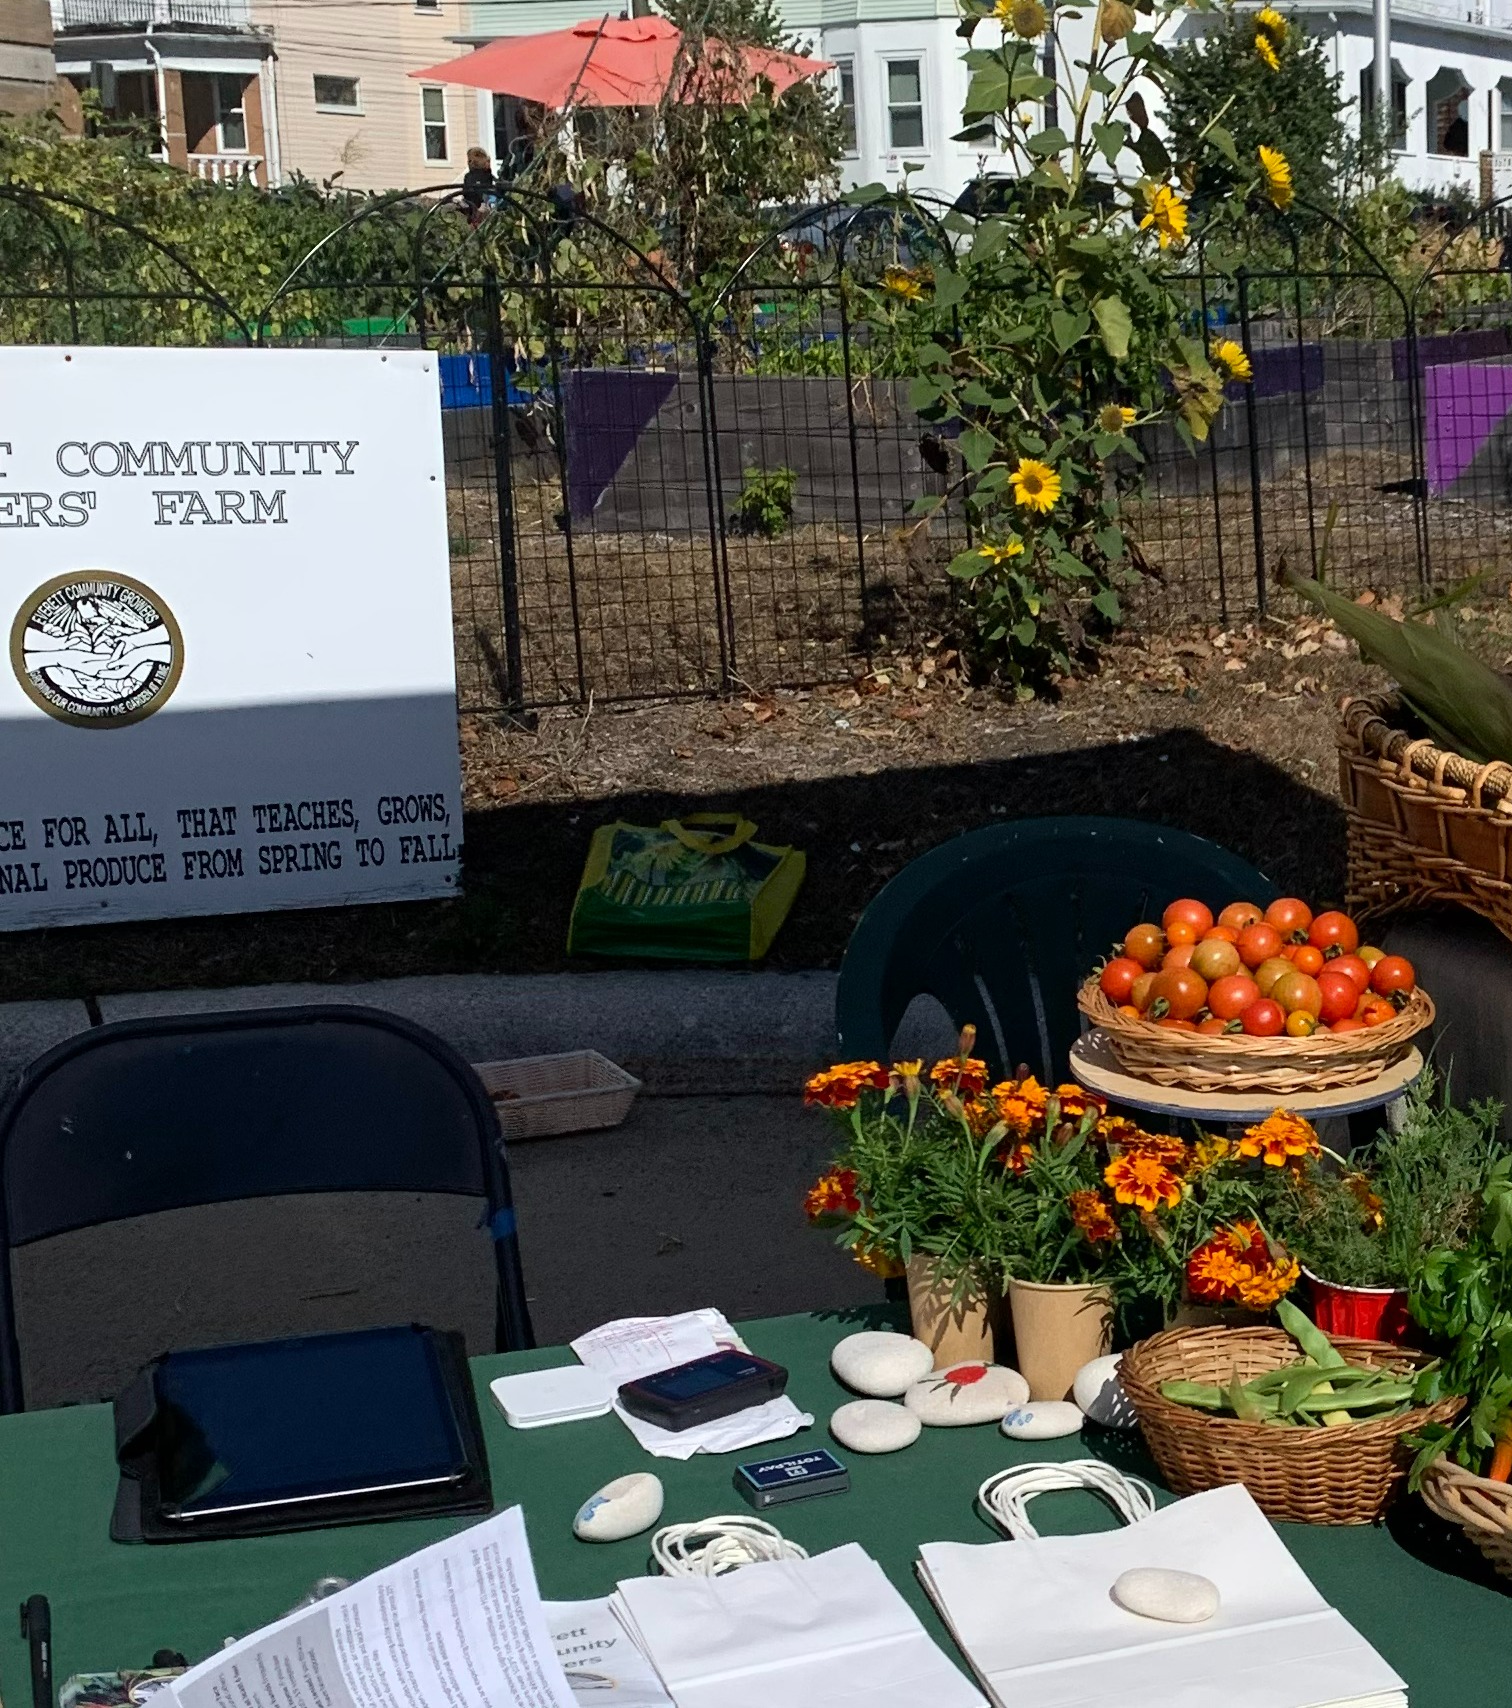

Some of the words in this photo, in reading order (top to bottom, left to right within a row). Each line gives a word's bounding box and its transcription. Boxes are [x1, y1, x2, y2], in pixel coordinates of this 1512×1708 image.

[56, 440, 360, 477] COMMUNITY
[152, 489, 289, 525] FARM
[31, 589, 67, 625] EVERETT
[65, 582, 121, 600] COMMUNITY
[119, 588, 160, 624] GROWERS
[51, 695, 68, 710] OUR
[66, 700, 112, 718] COMMUNITY
[111, 702, 127, 716] ONE
[125, 689, 154, 711] GARDEN
[158, 663, 170, 682] TIME
[42, 816, 90, 848] FOR
[104, 812, 158, 847] ALL,
[176, 806, 237, 839] THAT
[253, 799, 360, 833] TEACHES,
[378, 793, 450, 827] GROWS,
[63, 853, 167, 890] PRODUCE
[182, 847, 245, 880] FROM
[259, 840, 342, 875] SPRING
[356, 837, 385, 867] TO
[552, 1627, 587, 1641] ett
